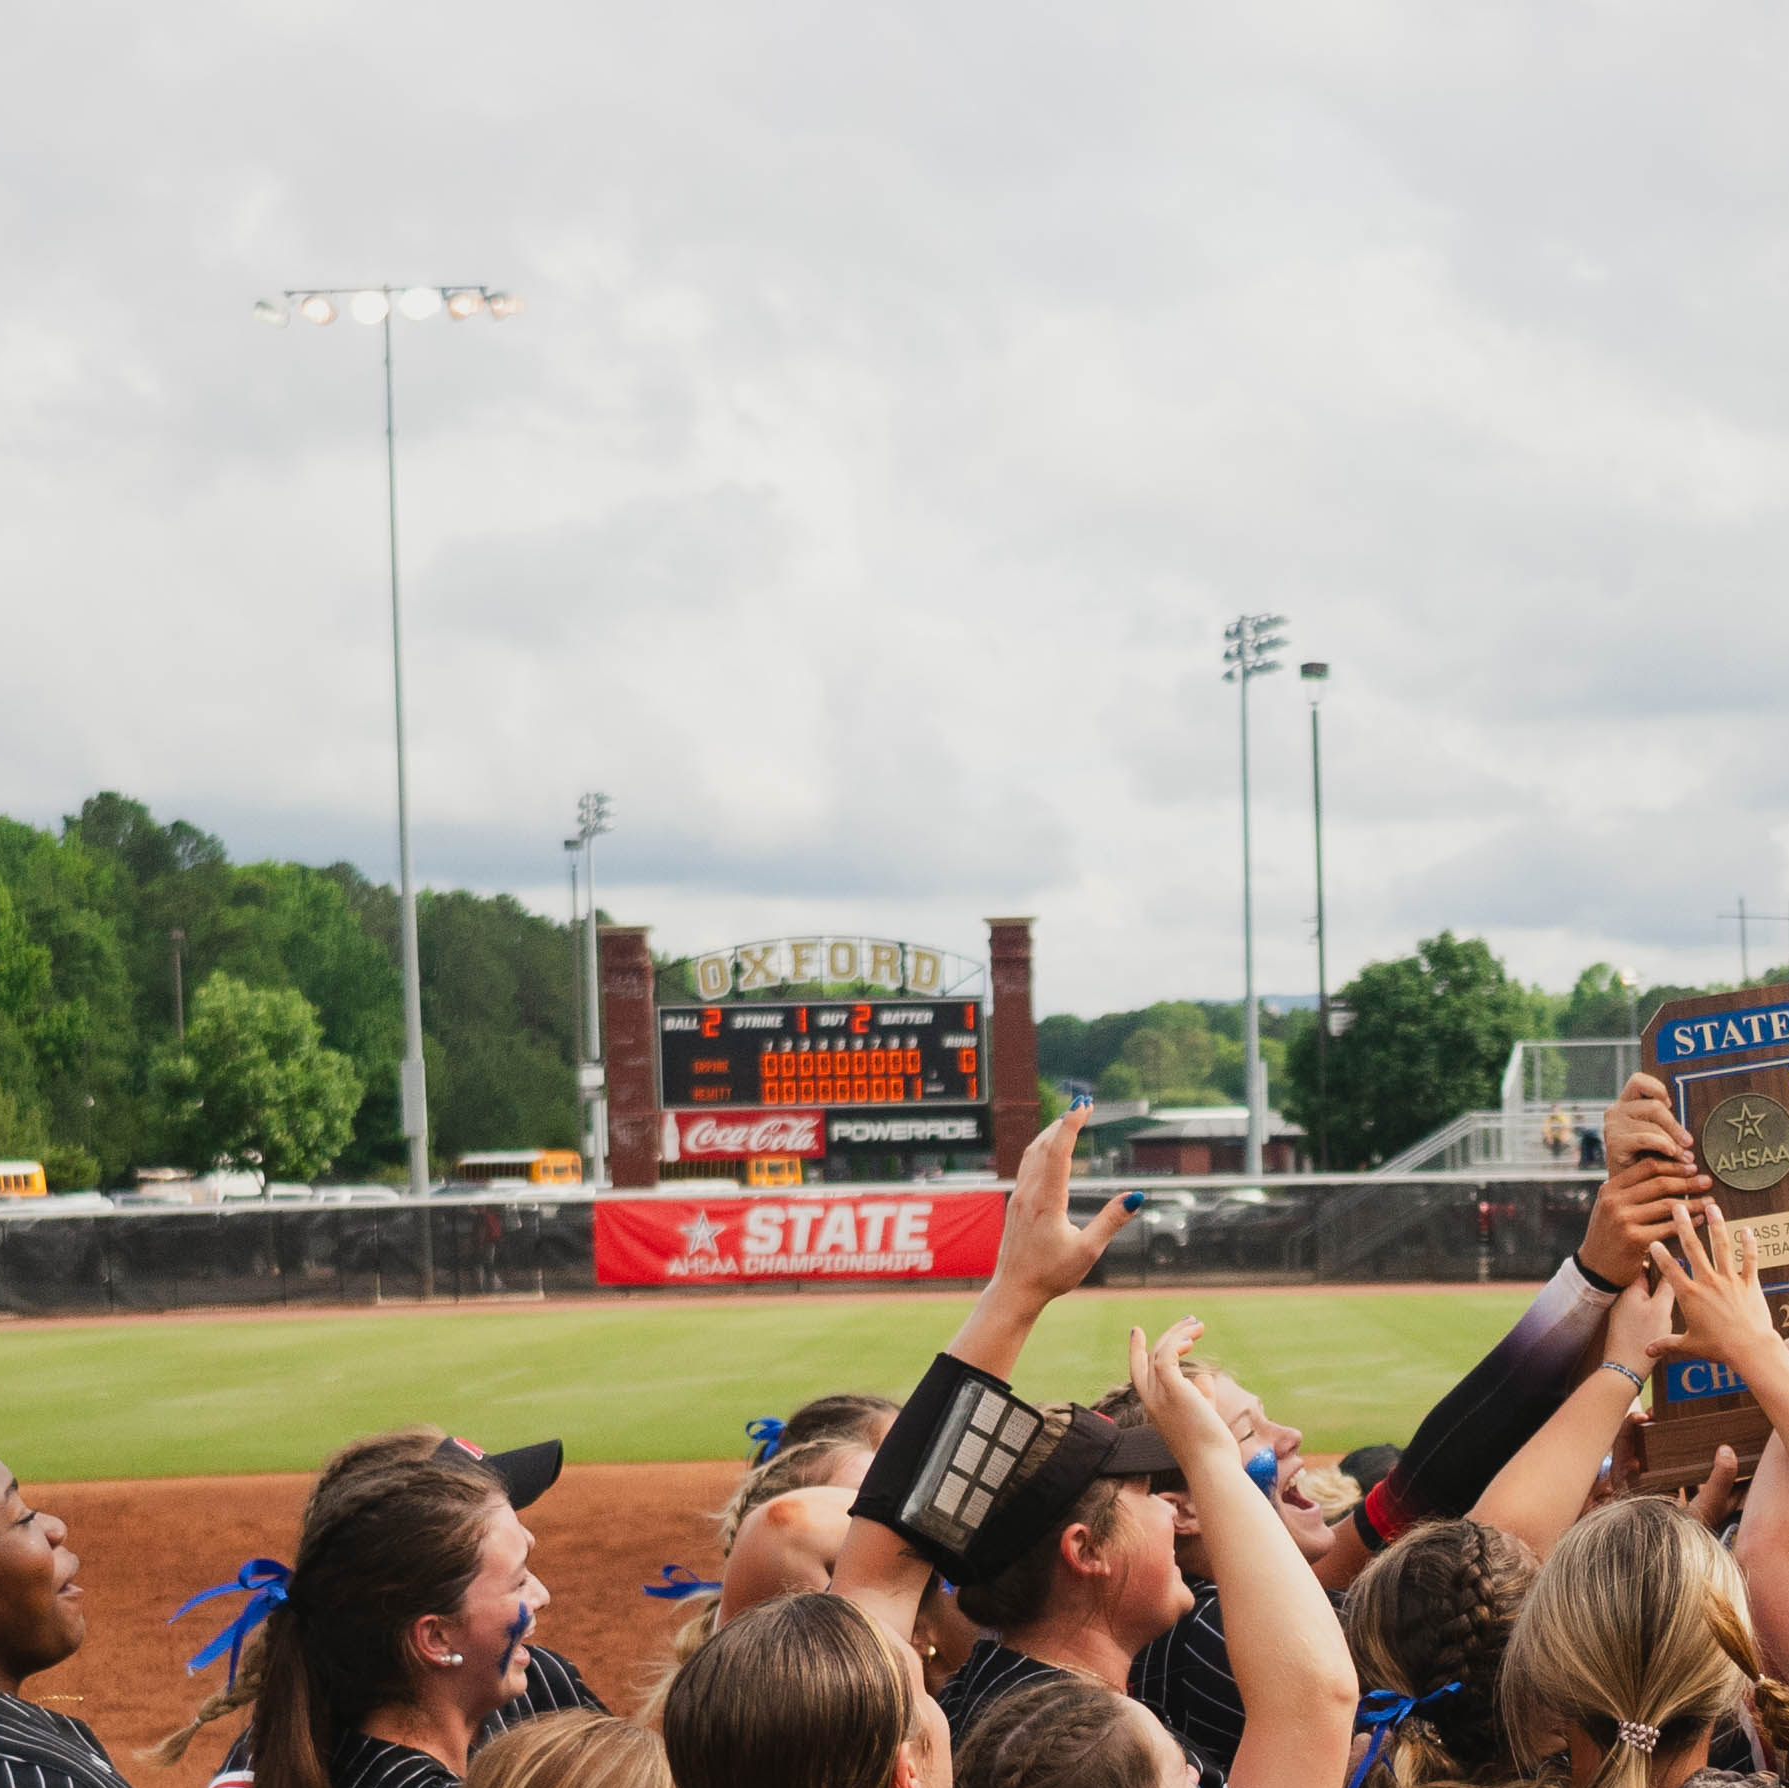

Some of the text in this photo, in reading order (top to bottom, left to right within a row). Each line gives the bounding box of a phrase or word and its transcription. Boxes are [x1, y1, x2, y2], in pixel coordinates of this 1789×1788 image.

[699, 941, 942, 998] OXFORD
[663, 1002, 975, 1038] BALL 2 STRIKE 1 OUT 2 BATTER 1
[833, 1119, 978, 1142] POWERADE
[743, 1202, 934, 1254] STATE
[1734, 1224, 1780, 1244] CASS
[668, 1252, 934, 1275] AHSAA CHAMPIONSHIPS
